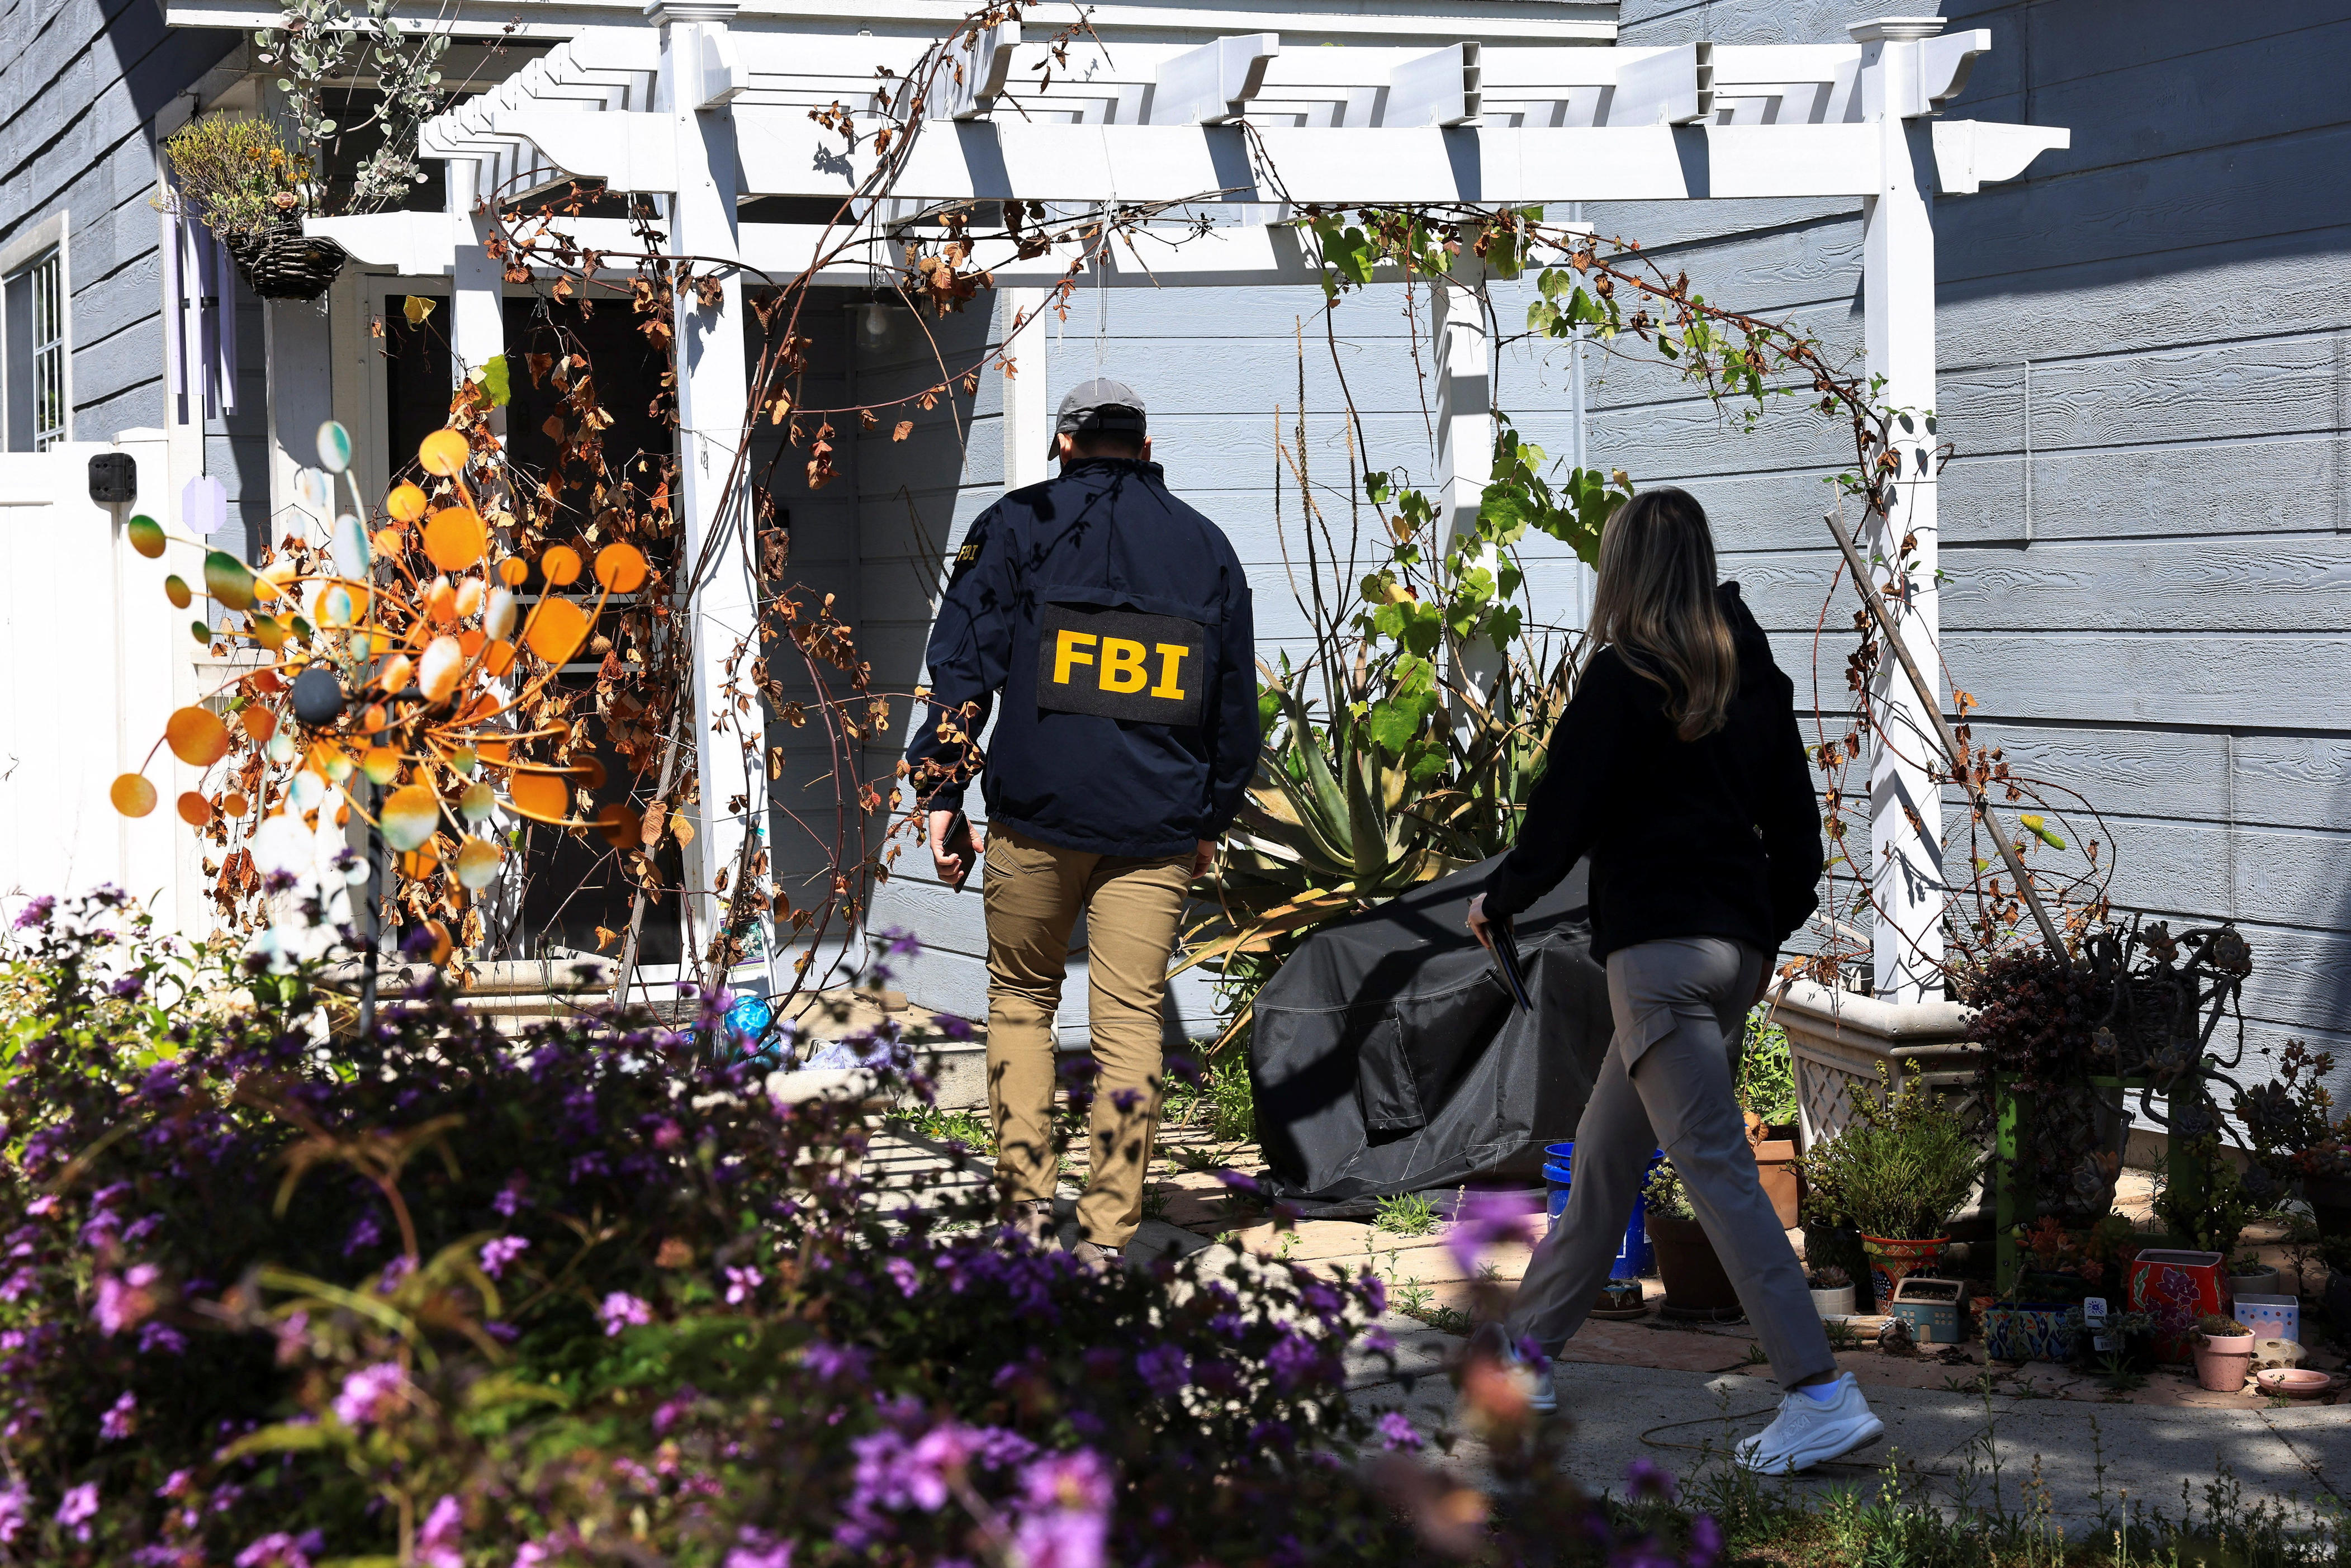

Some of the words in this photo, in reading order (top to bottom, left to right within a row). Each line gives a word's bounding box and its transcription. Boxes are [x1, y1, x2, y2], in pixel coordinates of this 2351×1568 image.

[957, 544, 978, 561] FBI
[1053, 629, 1189, 700] FBI
[1779, 1413, 1811, 1444] HOKA
